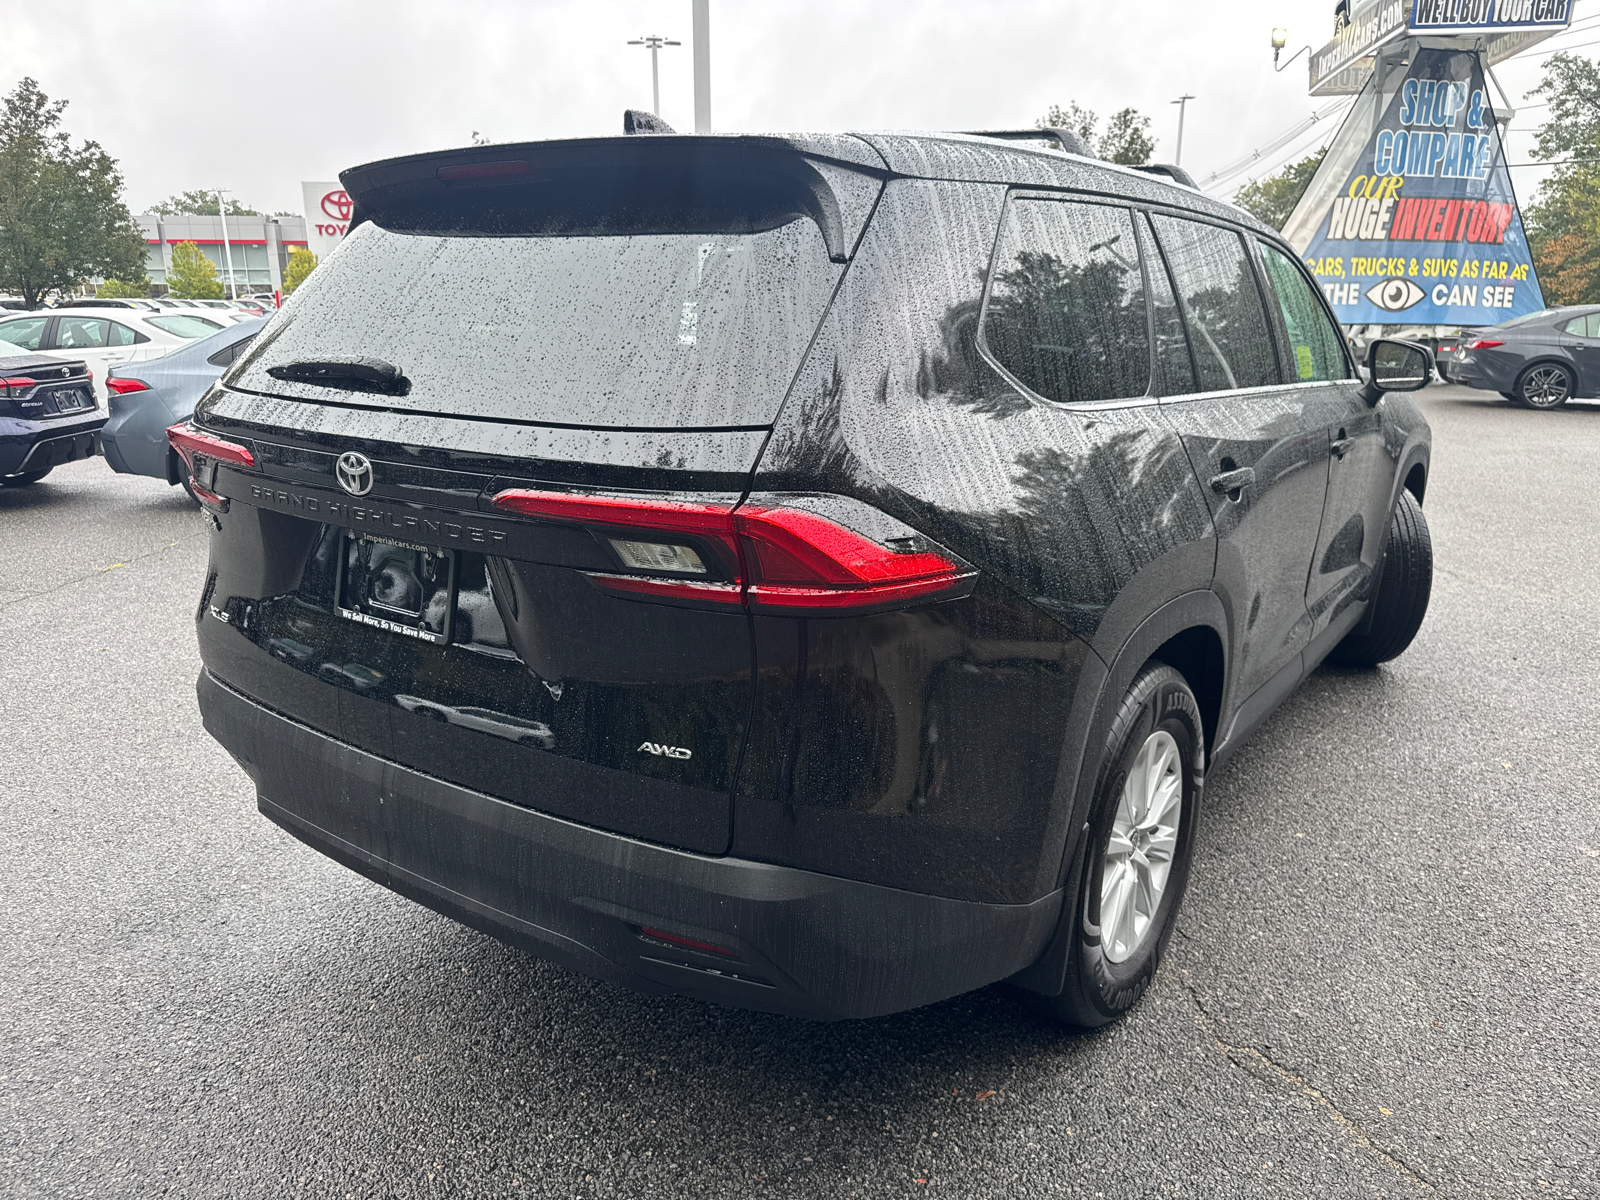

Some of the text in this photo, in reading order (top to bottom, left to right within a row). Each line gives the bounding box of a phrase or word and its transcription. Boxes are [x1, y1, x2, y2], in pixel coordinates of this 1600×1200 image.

[1533, 0, 1568, 22] CAR
[1400, 77, 1469, 128] SHOP
[1467, 90, 1484, 129] &
[1374, 129, 1491, 180] COMPARE
[1349, 175, 1404, 201] OUR
[315, 224, 349, 236] TOY
[1326, 197, 1514, 243] HUGE INVENTORY
[1351, 257, 1405, 277] TRUCKS
[1408, 258, 1418, 277] &
[1423, 259, 1457, 278] SUVS
[1460, 259, 1479, 279] AS
[1482, 260, 1508, 280] FAR
[1510, 262, 1529, 281] AS
[1323, 283, 1514, 308] THE CAN SEE
[251, 484, 508, 546] GRAND HIGHLANDER
[342, 610, 436, 642] We Sell More, So You Save More
[637, 741, 692, 760] AWD
